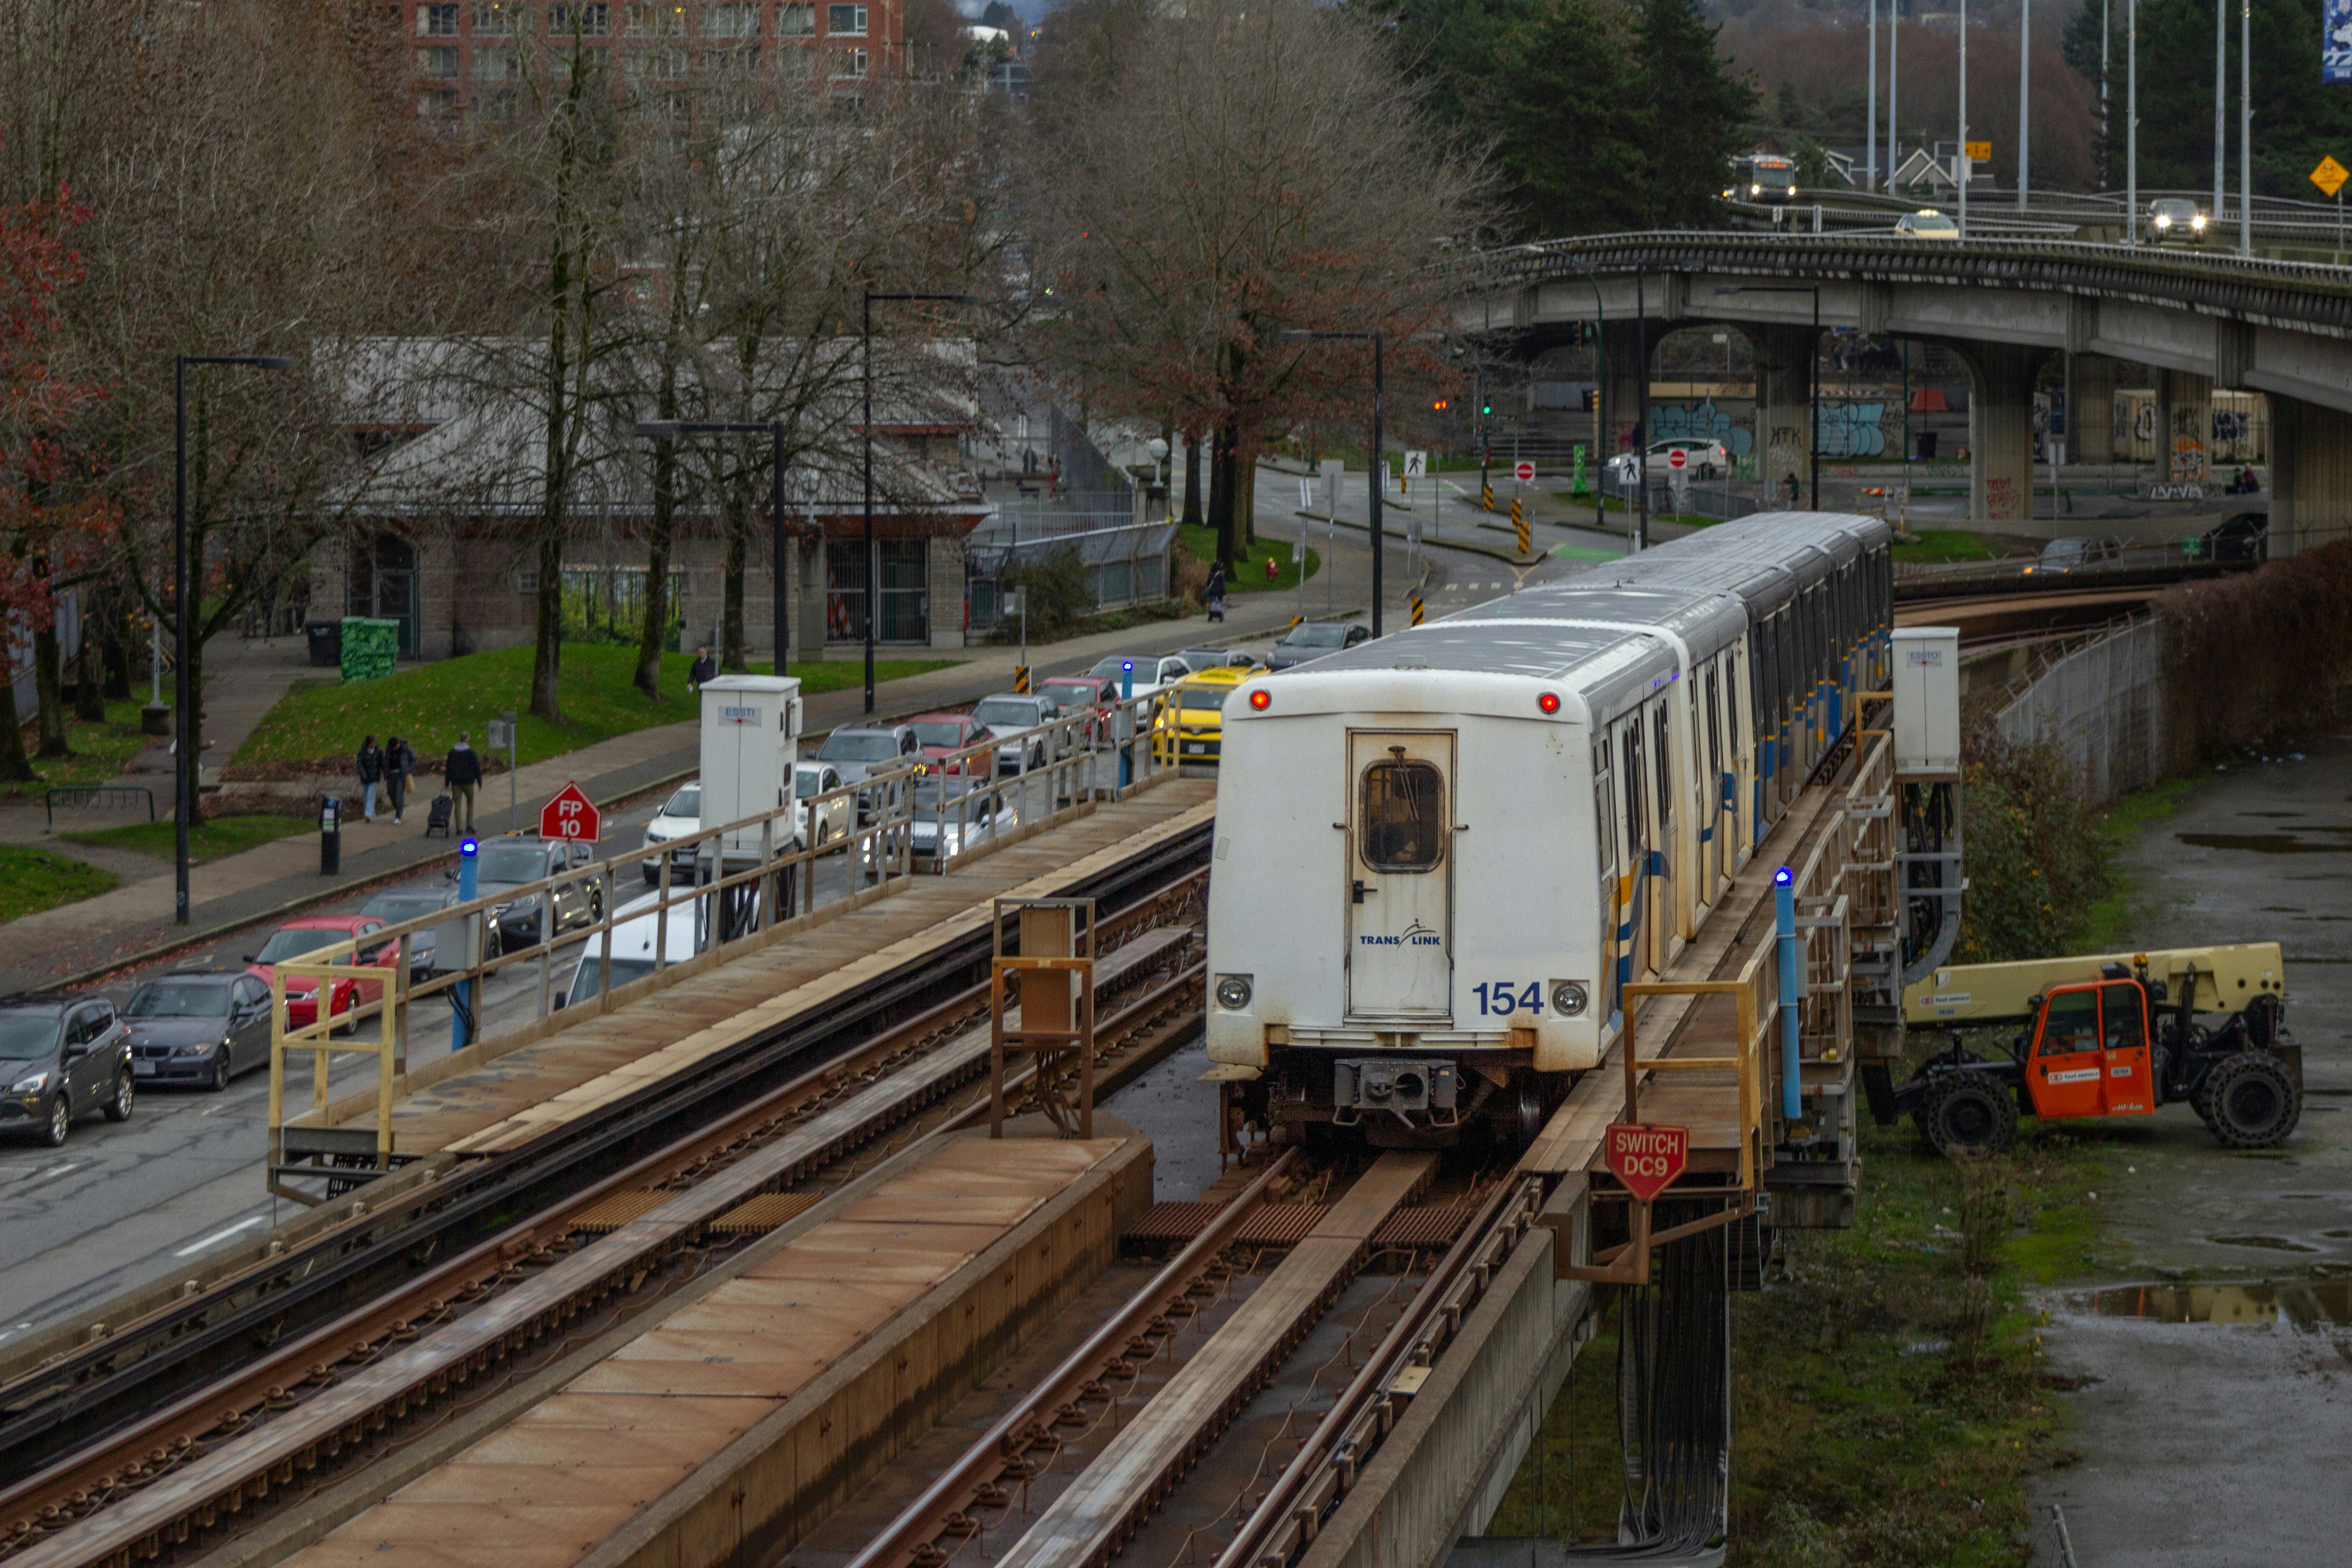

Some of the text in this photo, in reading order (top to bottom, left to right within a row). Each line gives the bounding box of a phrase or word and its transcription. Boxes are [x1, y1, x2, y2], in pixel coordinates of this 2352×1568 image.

[559, 799, 583, 817] FP
[559, 819, 581, 837] 10
[1360, 936, 1441, 945] TRANS LINK
[1472, 981, 1544, 1015] 154
[1616, 1132, 1679, 1155] SWITCH
[1624, 1155, 1668, 1177] DC9
